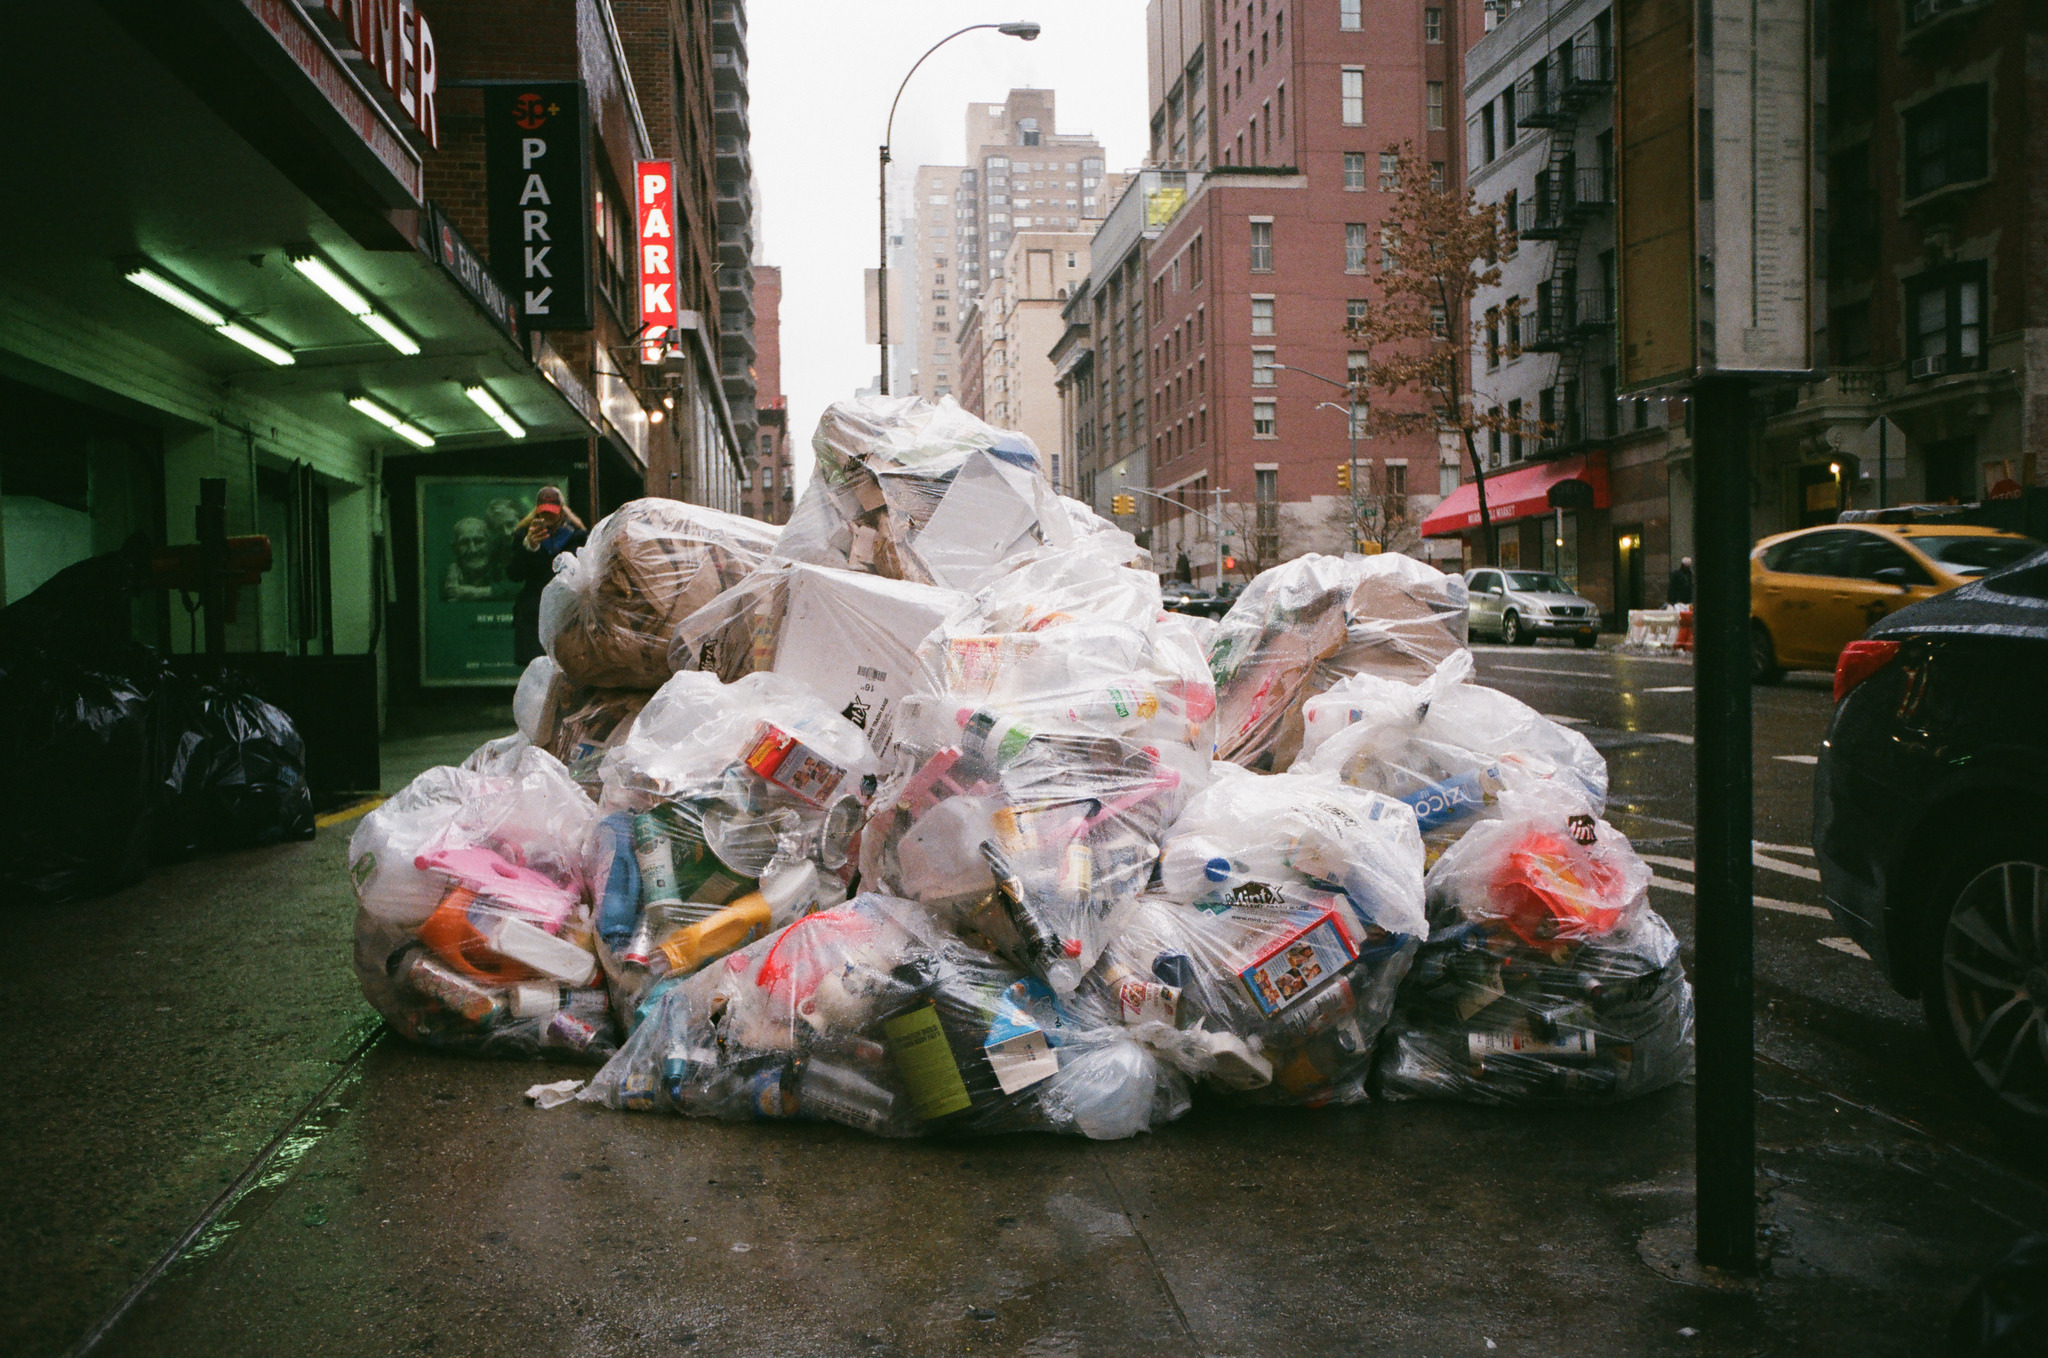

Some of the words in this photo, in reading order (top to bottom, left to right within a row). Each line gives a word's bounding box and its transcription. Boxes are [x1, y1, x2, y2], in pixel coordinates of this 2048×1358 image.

[519, 138, 552, 278] PARK
[643, 174, 673, 314] PARK
[1415, 785, 1465, 818] ZICO
